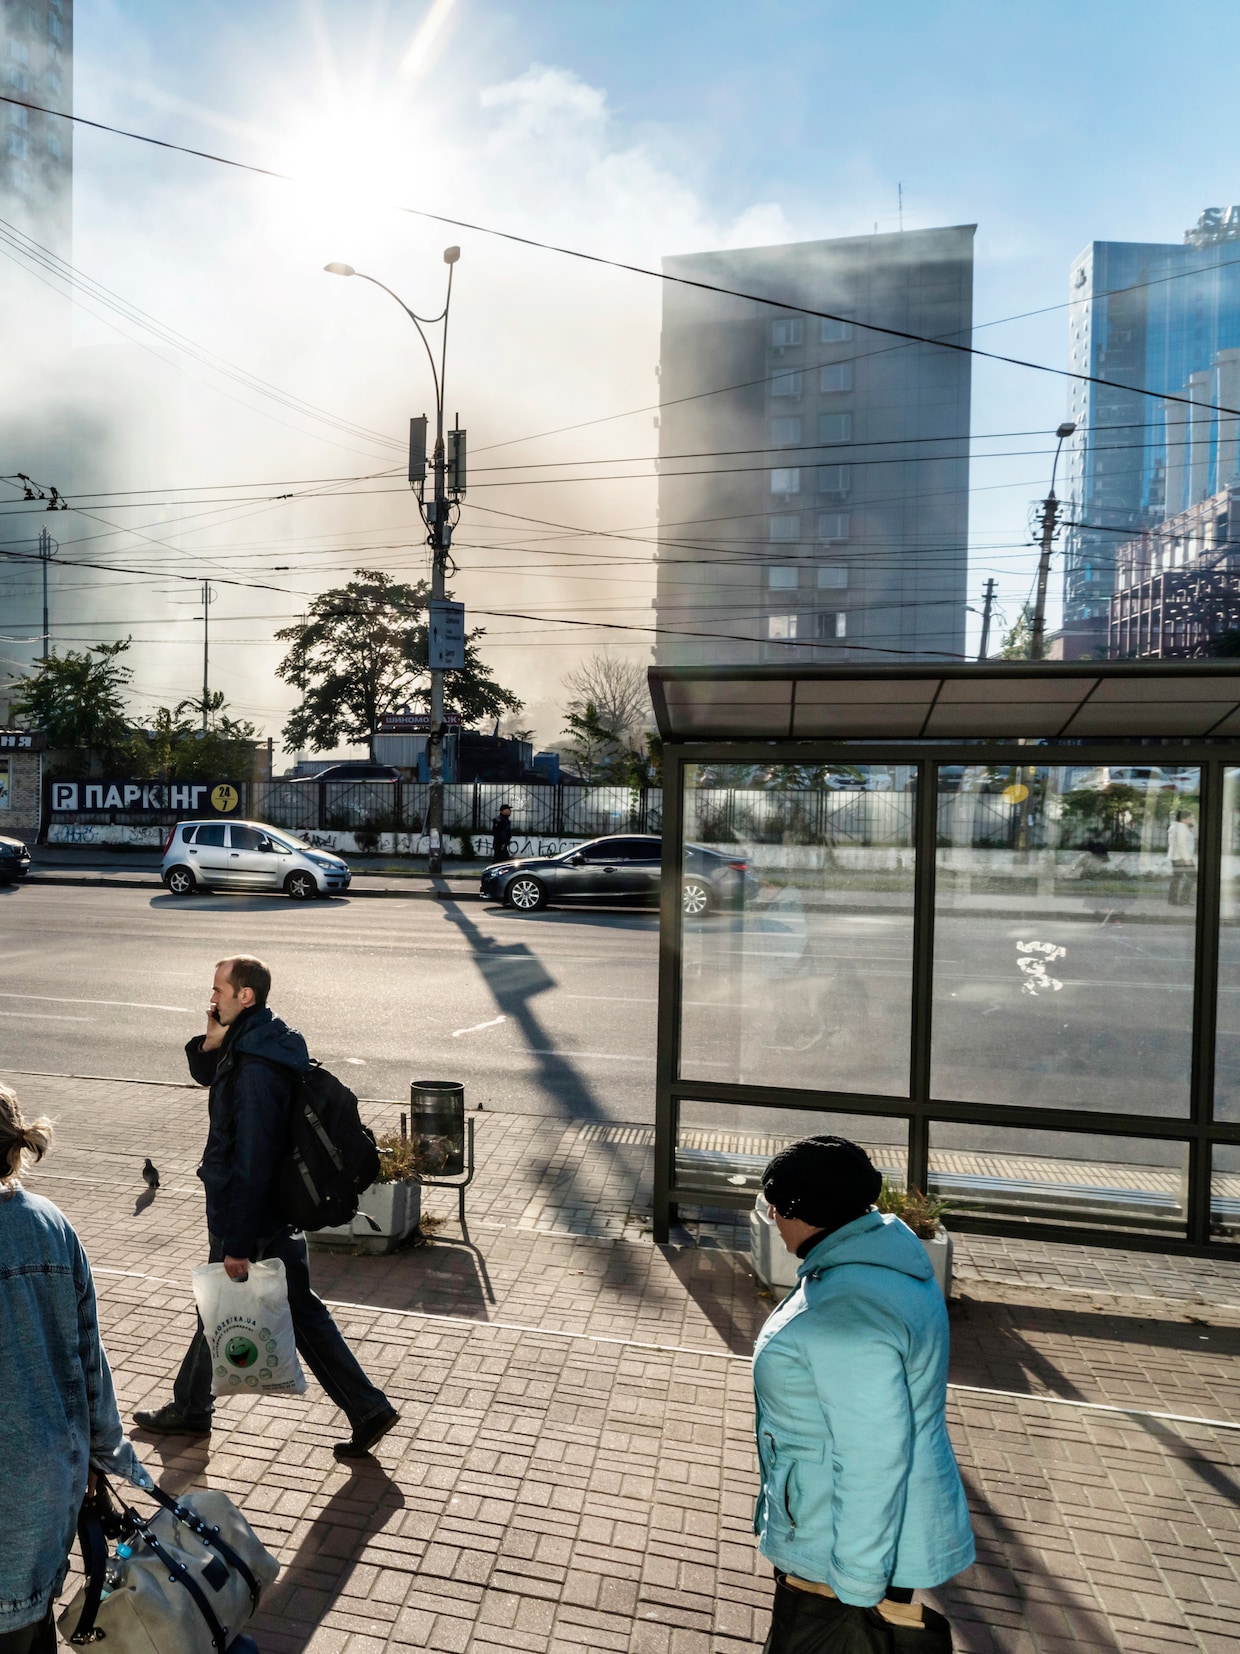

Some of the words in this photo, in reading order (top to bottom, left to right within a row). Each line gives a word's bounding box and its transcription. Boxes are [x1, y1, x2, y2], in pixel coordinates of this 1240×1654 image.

[85, 784, 208, 810] ПАРКІНГ
[218, 786, 231, 798] 24
[222, 800, 228, 811] 7
